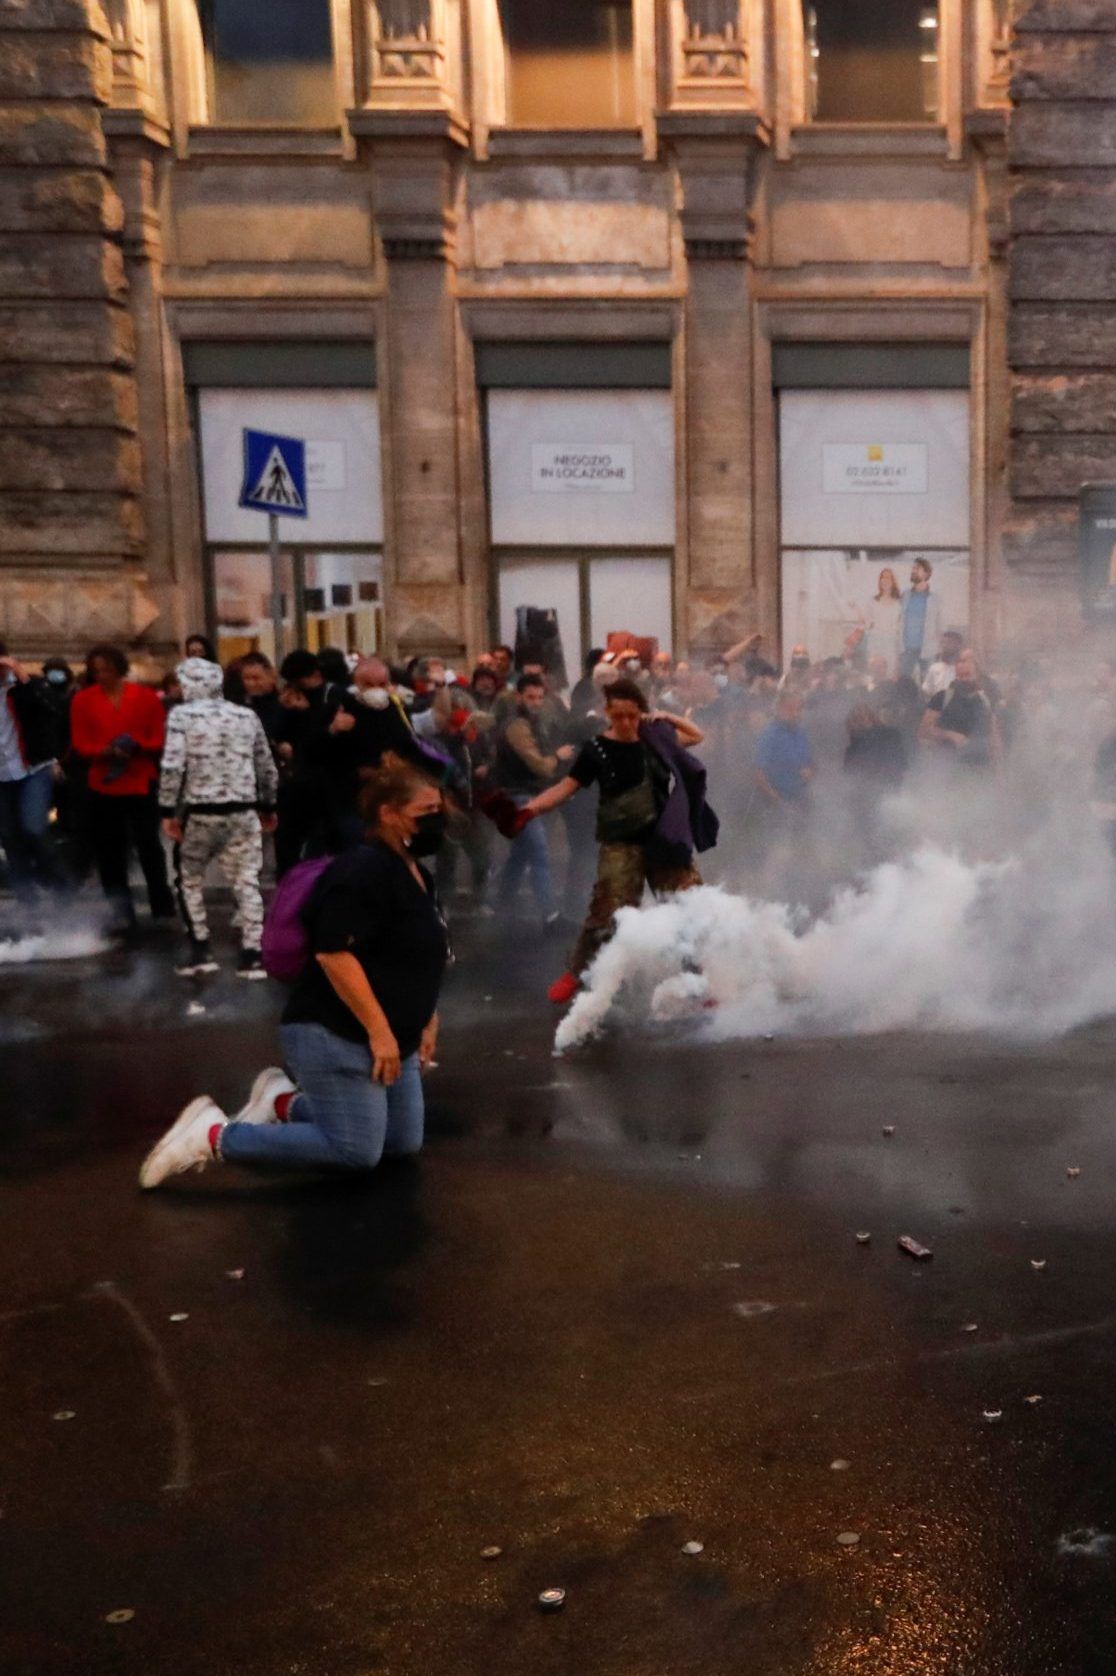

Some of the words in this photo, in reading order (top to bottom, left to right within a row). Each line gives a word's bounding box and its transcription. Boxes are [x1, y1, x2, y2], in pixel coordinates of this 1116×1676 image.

[554, 455, 611, 466] NEGOZIO
[541, 468, 553, 478] IN
[556, 468, 625, 478] LOCAZIONE
